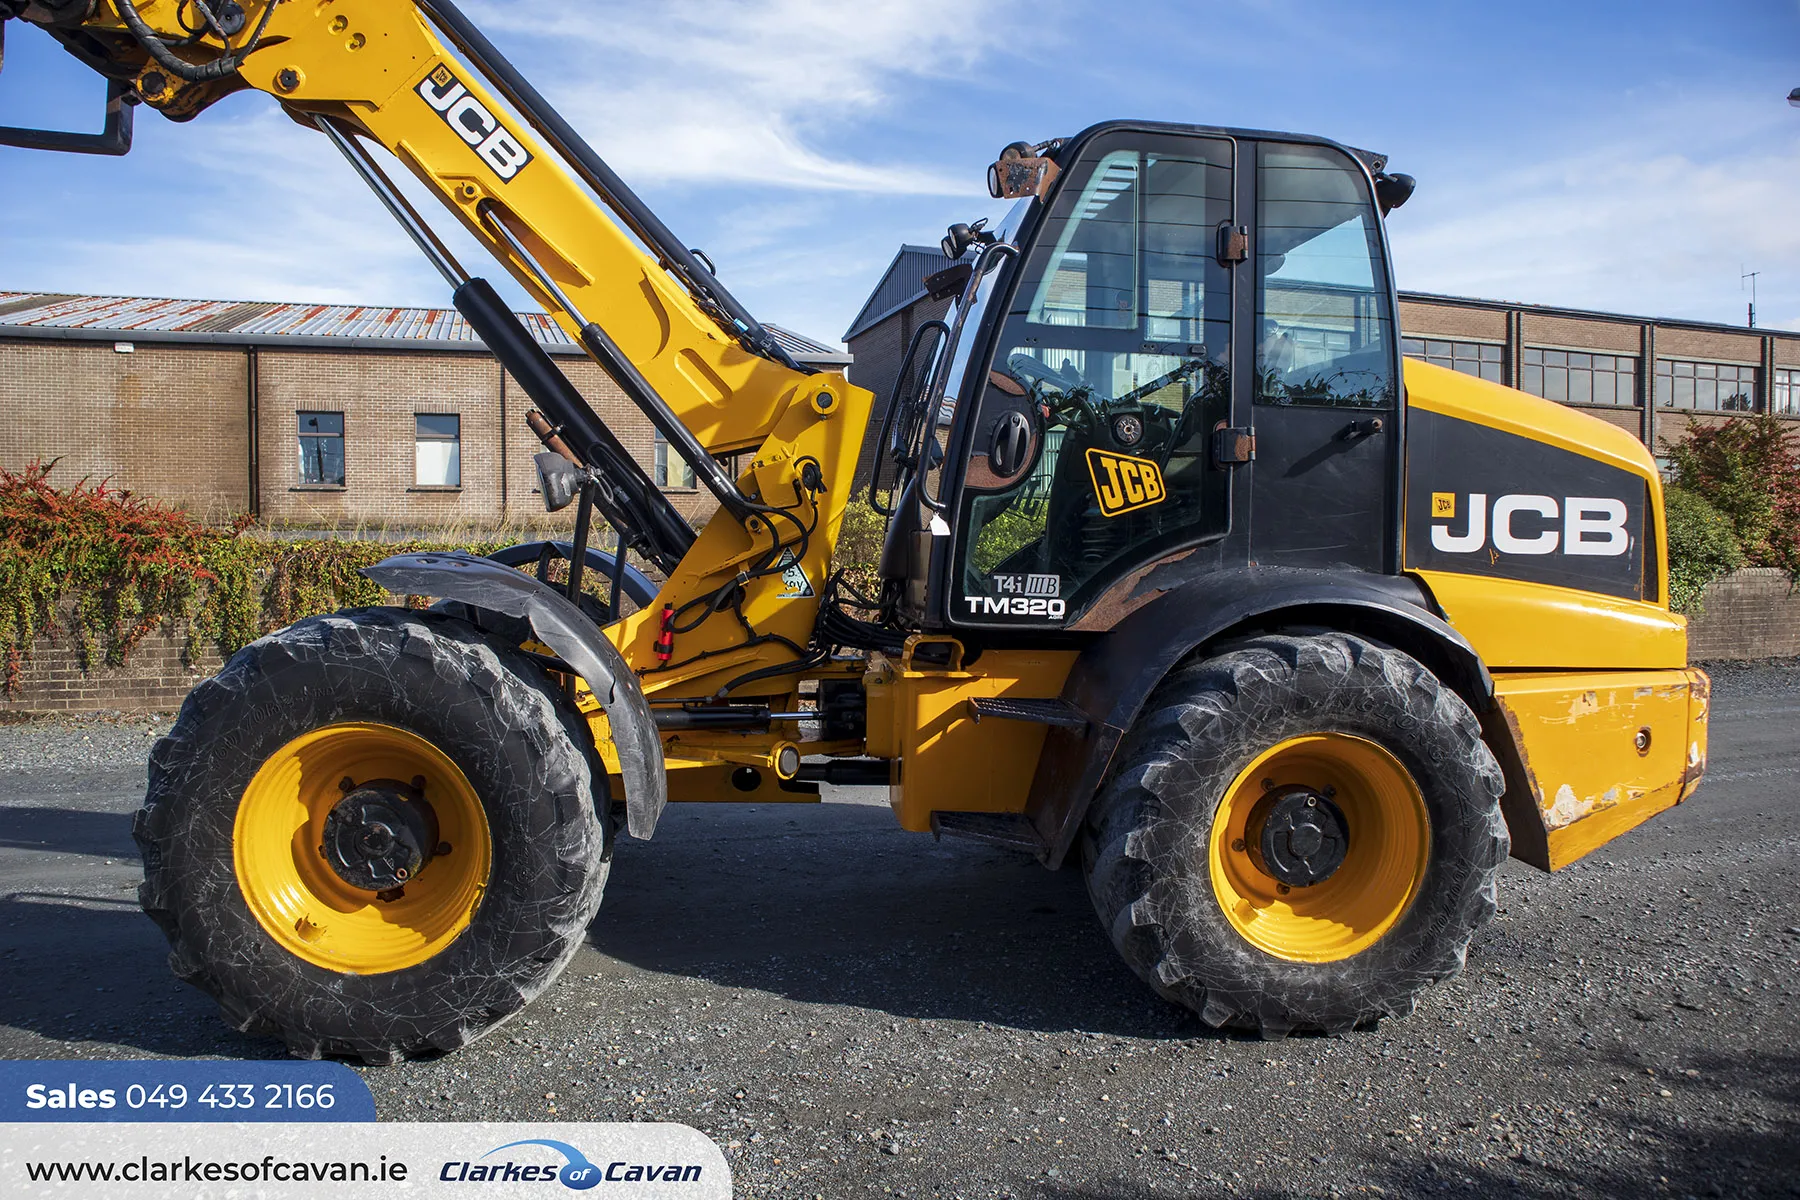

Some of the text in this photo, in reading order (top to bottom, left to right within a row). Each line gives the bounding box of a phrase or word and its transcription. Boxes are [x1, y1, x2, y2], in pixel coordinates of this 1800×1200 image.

[419, 78, 528, 179] JCB
[1100, 456, 1161, 509] JCB
[1431, 493, 1629, 556] JCB
[964, 596, 1066, 616] TM320
[993, 575, 1023, 594] T4i
